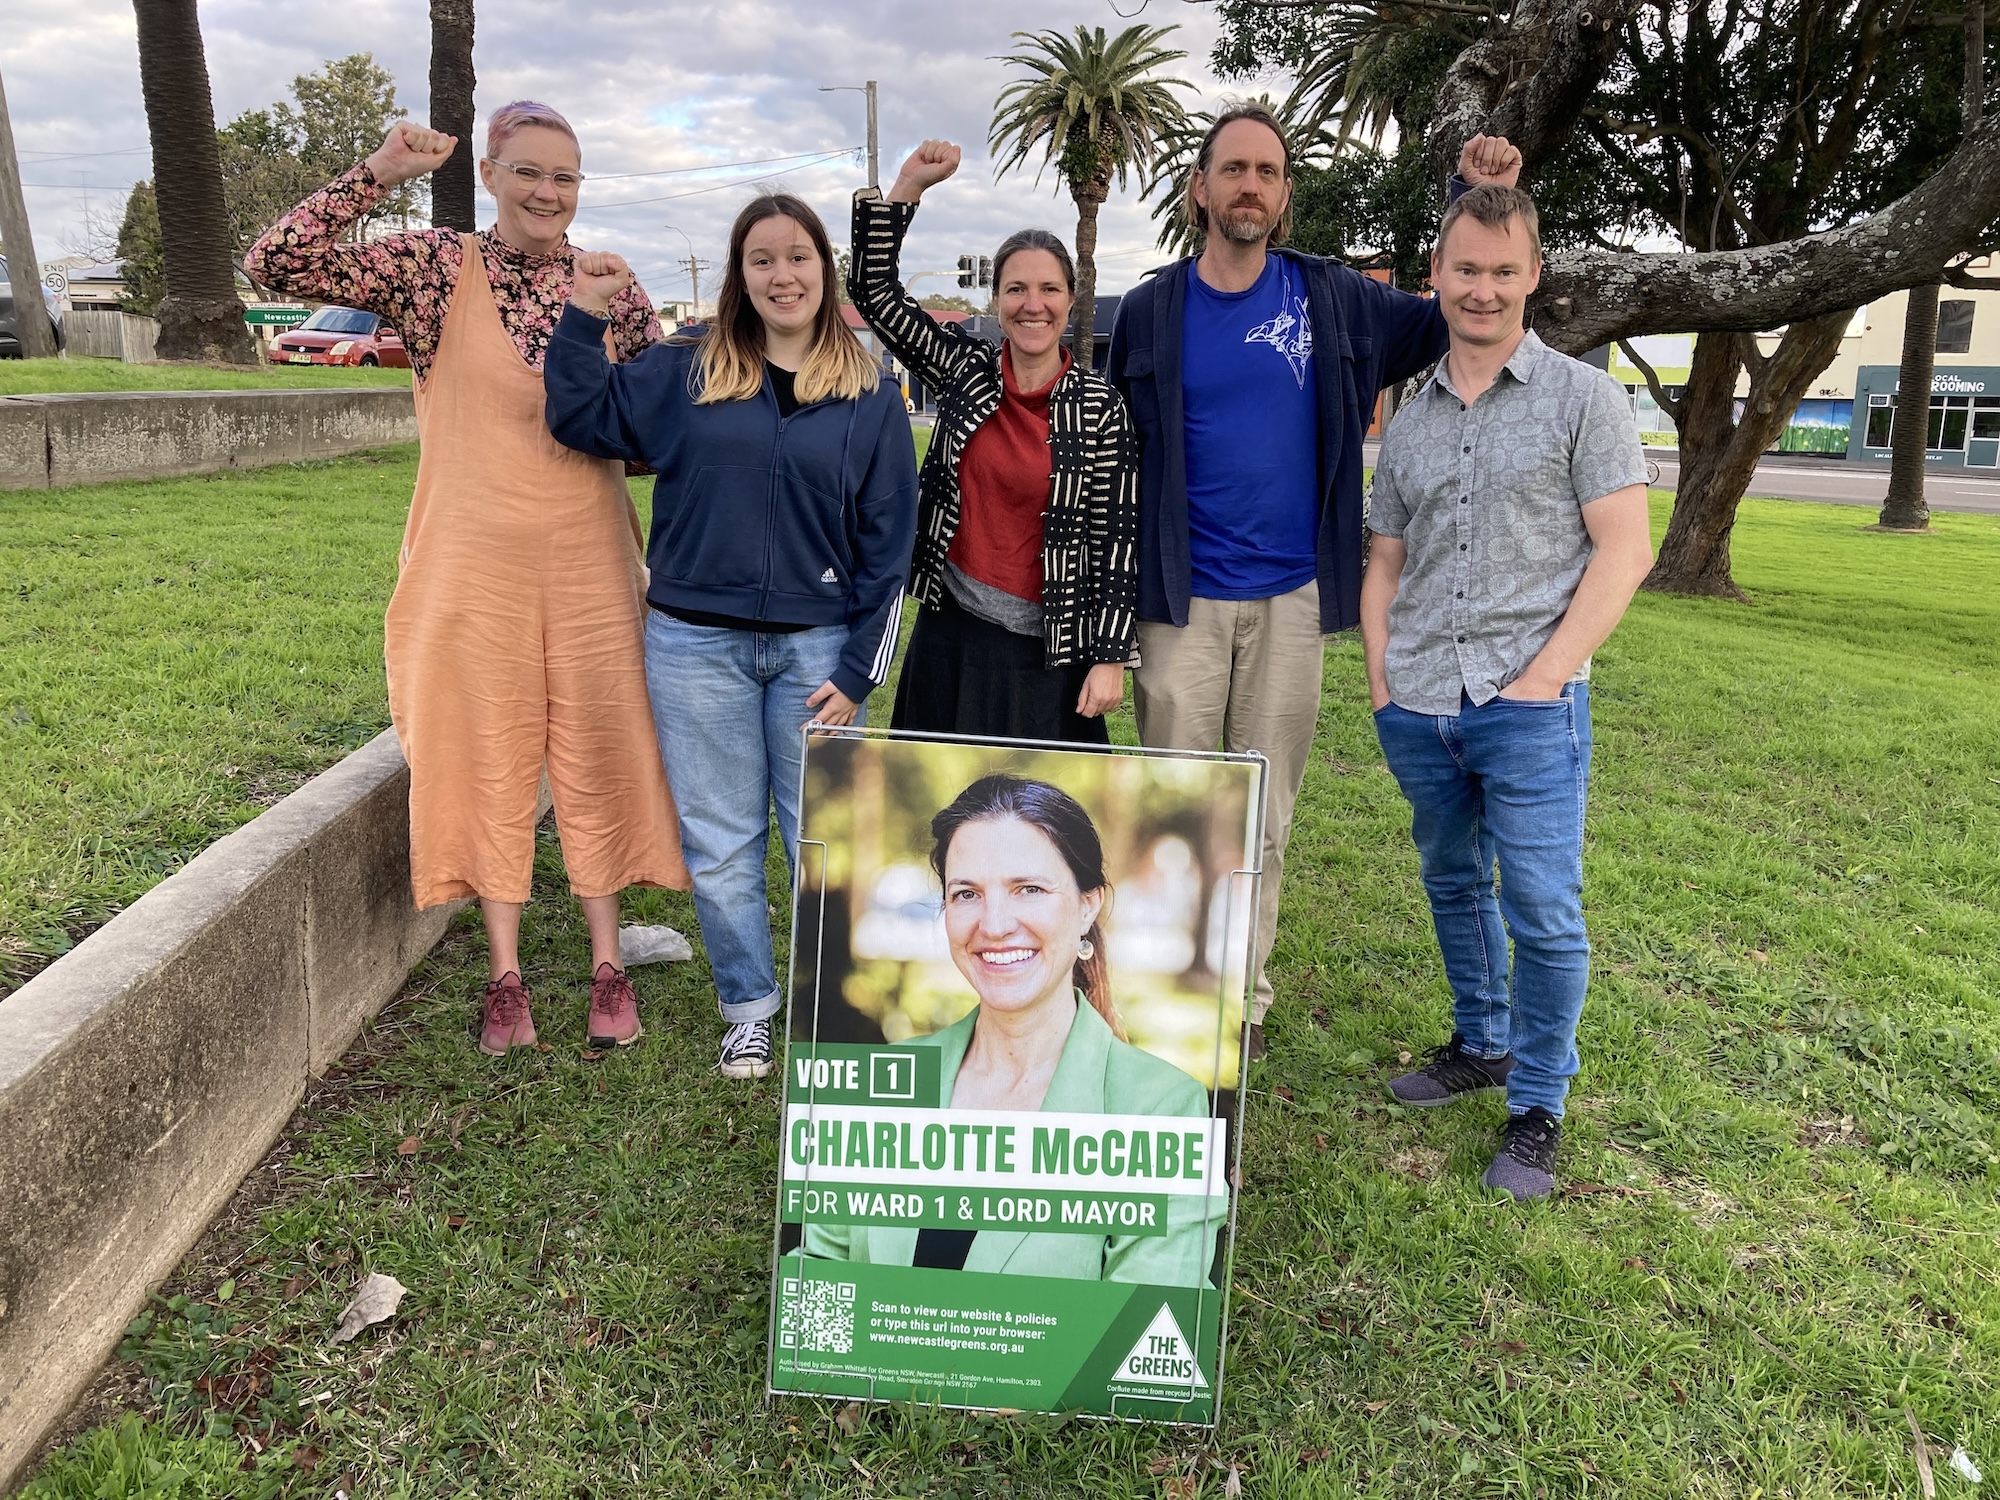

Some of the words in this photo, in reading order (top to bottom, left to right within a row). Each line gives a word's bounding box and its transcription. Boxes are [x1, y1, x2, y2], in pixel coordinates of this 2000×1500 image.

[44, 264, 64, 272] END
[48, 277, 63, 288] 50
[264, 313, 307, 321] Newcastle
[1930, 381, 1985, 393] ROOMING
[1932, 374, 1962, 382] OCAL
[795, 1058, 859, 1090] VOTE
[887, 1062, 898, 1090] 1
[790, 1118, 1015, 1174] CHARLOTTE
[1032, 1127, 1205, 1180] McCABE
[787, 1189, 838, 1215] FOR
[847, 1191, 924, 1218] WARD
[934, 1195, 945, 1219] 1
[957, 1195, 974, 1220] &
[982, 1196, 1052, 1223] LORD
[1060, 1199, 1156, 1227] MAYOR
[871, 1301, 897, 1314] Scan
[900, 1304, 911, 1315] to
[913, 1304, 938, 1317] view
[940, 1307, 958, 1318] our
[960, 1308, 1002, 1322] website
[1004, 1311, 1013, 1323] &
[1015, 1312, 1058, 1326] policies
[870, 1318, 882, 1327] or
[884, 1318, 908, 1331] type
[910, 1319, 930, 1332] this
[932, 1321, 947, 1332] url
[950, 1322, 970, 1334] into
[973, 1325, 997, 1338] your
[999, 1326, 1046, 1340] browser:
[869, 1332, 1025, 1355] www.newcastlegreens.org.au
[1148, 1335, 1179, 1356] THE
[778, 1358, 811, 1368] Authised
[811, 1361, 820, 1370] by
[820, 1361, 844, 1371] Graham
[844, 1363, 868, 1373] Whittall
[868, 1365, 877, 1374] for
[877, 1366, 899, 1375] Greens
[916, 1370, 949, 1380] Newcastl,
[959, 1373, 981, 1382] Gordon
[982, 1375, 995, 1384] Ave,
[995, 1376, 1025, 1386] Hamilton,
[778, 1365, 800, 1374] Printe
[945, 1379, 961, 1388] NSW
[1128, 1355, 1192, 1379] GREENS
[1106, 1384, 1131, 1393] Corflute
[1131, 1386, 1149, 1395] made
[1149, 1387, 1165, 1396] from
[1165, 1389, 1190, 1399] recycled
[1193, 1391, 1212, 1400] lastic
